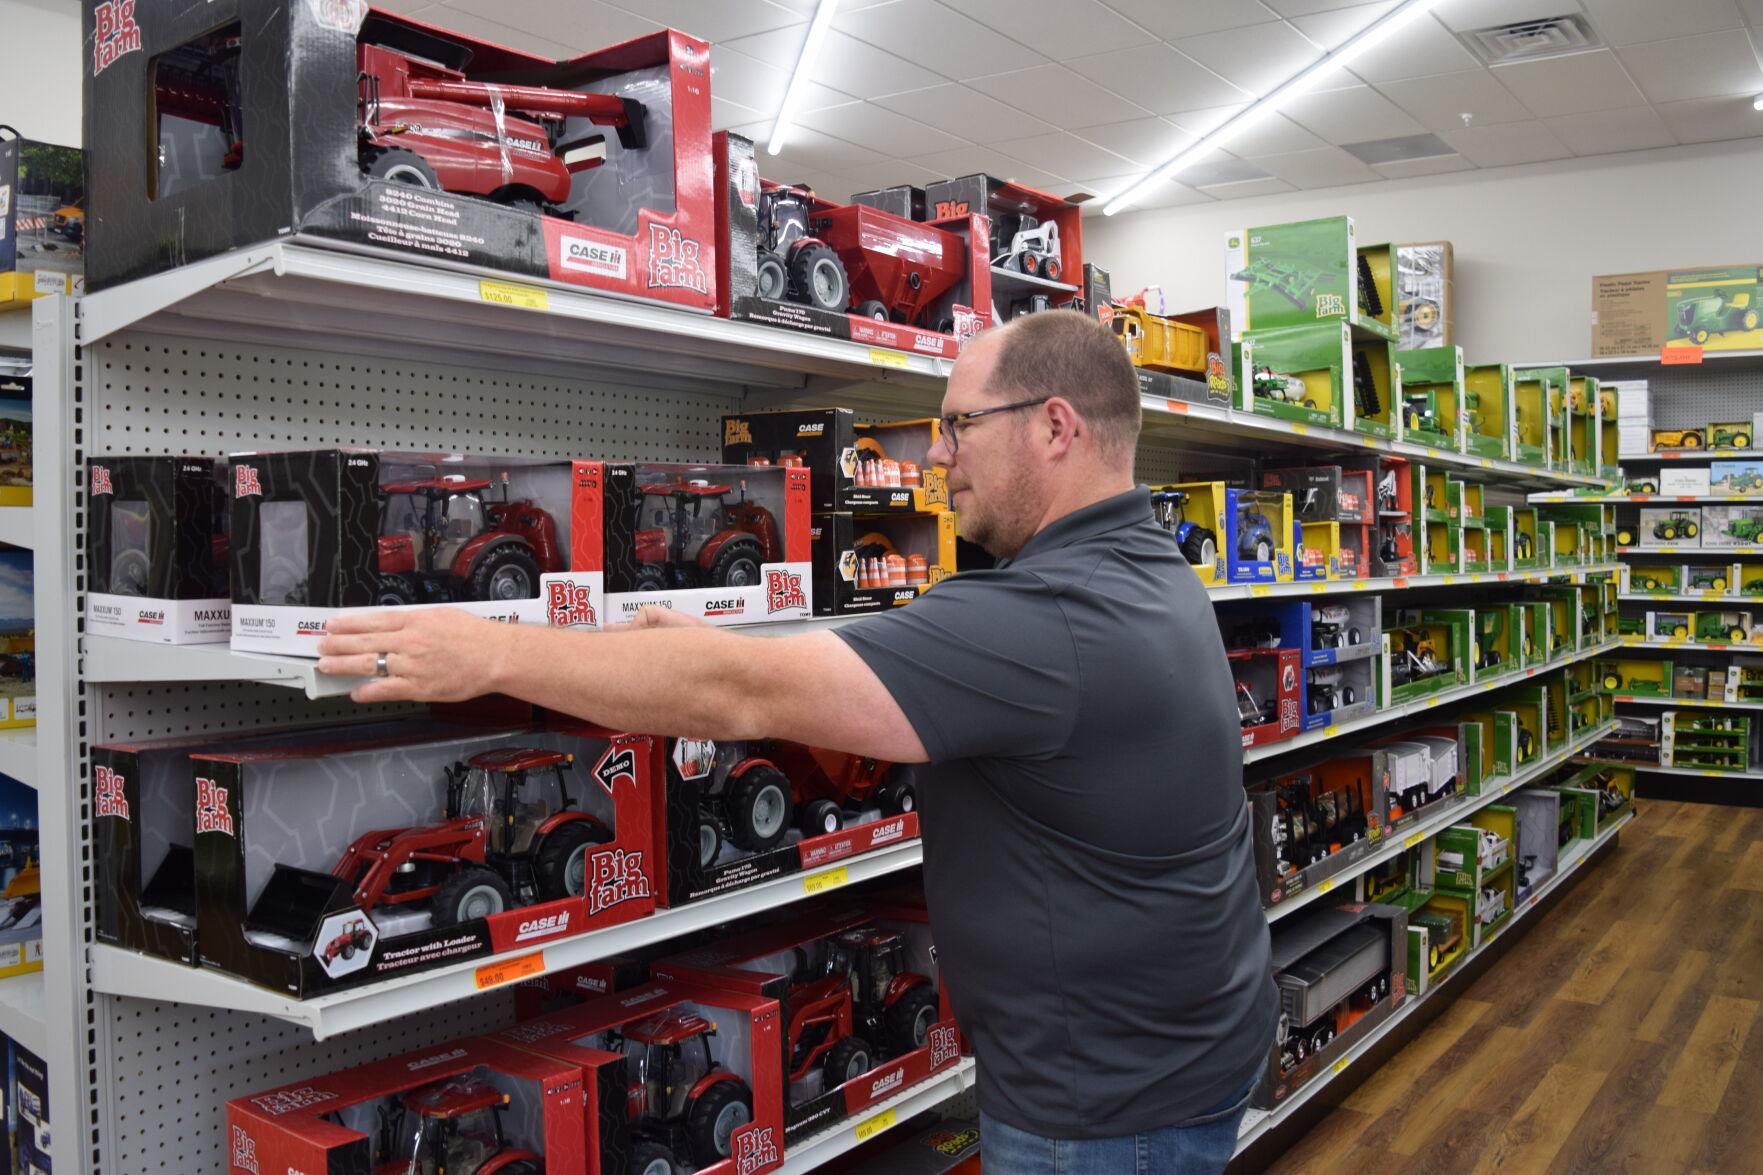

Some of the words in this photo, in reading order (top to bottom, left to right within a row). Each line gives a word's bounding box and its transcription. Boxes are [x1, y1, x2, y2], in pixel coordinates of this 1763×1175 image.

[95, 0, 135, 41] Big
[94, 26, 141, 76] farm
[385, 188, 413, 200] 8240
[414, 194, 455, 210] Combine
[407, 201, 435, 213] Grain
[437, 208, 460, 219] Head
[408, 209, 433, 221] Corn
[434, 215, 458, 226] Head
[935, 200, 969, 220] Big
[405, 232, 437, 244] grains
[649, 222, 699, 271] Big
[570, 244, 608, 261] CASE
[648, 256, 708, 295] farm
[1316, 294, 1342, 309] Big
[915, 334, 936, 347] CASE
[725, 419, 750, 436] Big
[798, 423, 825, 432] CASE
[92, 465, 110, 484] Big
[235, 464, 258, 486] Big
[924, 472, 945, 492] Big
[92, 480, 113, 496] farm
[235, 481, 262, 498] farm
[891, 492, 910, 501] CASE
[766, 569, 802, 595] Big
[547, 580, 591, 610] Big
[767, 591, 808, 614] farm
[894, 590, 915, 600] CASE
[93, 604, 113, 615] MAXXUM
[113, 606, 122, 616] 150
[139, 610, 157, 619] CASE
[705, 600, 735, 610] CASE
[194, 609, 231, 621] MAXXU
[240, 617, 264, 627] MAXXUM
[547, 605, 597, 626] farm
[298, 621, 320, 630] CASE
[1280, 698, 1298, 719] Big
[603, 760, 630, 777] DEMO
[95, 765, 125, 800] Big
[195, 777, 228, 814] Big
[95, 791, 130, 820] farm
[196, 803, 234, 837] farm
[872, 825, 896, 839] CASE
[591, 848, 643, 883] Big
[723, 866, 741, 876] Puma
[715, 873, 739, 885] Gravity
[739, 868, 758, 879] Wagon
[590, 876, 650, 916] farm
[689, 884, 720, 898] Remorque
[518, 915, 557, 934] CASE
[376, 956, 420, 972] Tracteur
[419, 952, 442, 963] avec
[441, 942, 483, 959] chargeur
[383, 948, 421, 961] Tractor
[421, 941, 444, 953] with
[443, 934, 477, 949] Loader
[577, 976, 598, 987] CASE
[930, 1026, 955, 1049] Big
[407, 1053, 451, 1068] CASE
[930, 1042, 959, 1071] farm
[872, 1074, 896, 1091] CASE
[785, 1119, 808, 1134] Magnum
[232, 1124, 256, 1156] Big
[737, 1127, 773, 1155] Big
[232, 1148, 259, 1175] farm
[736, 1145, 778, 1175] farm
